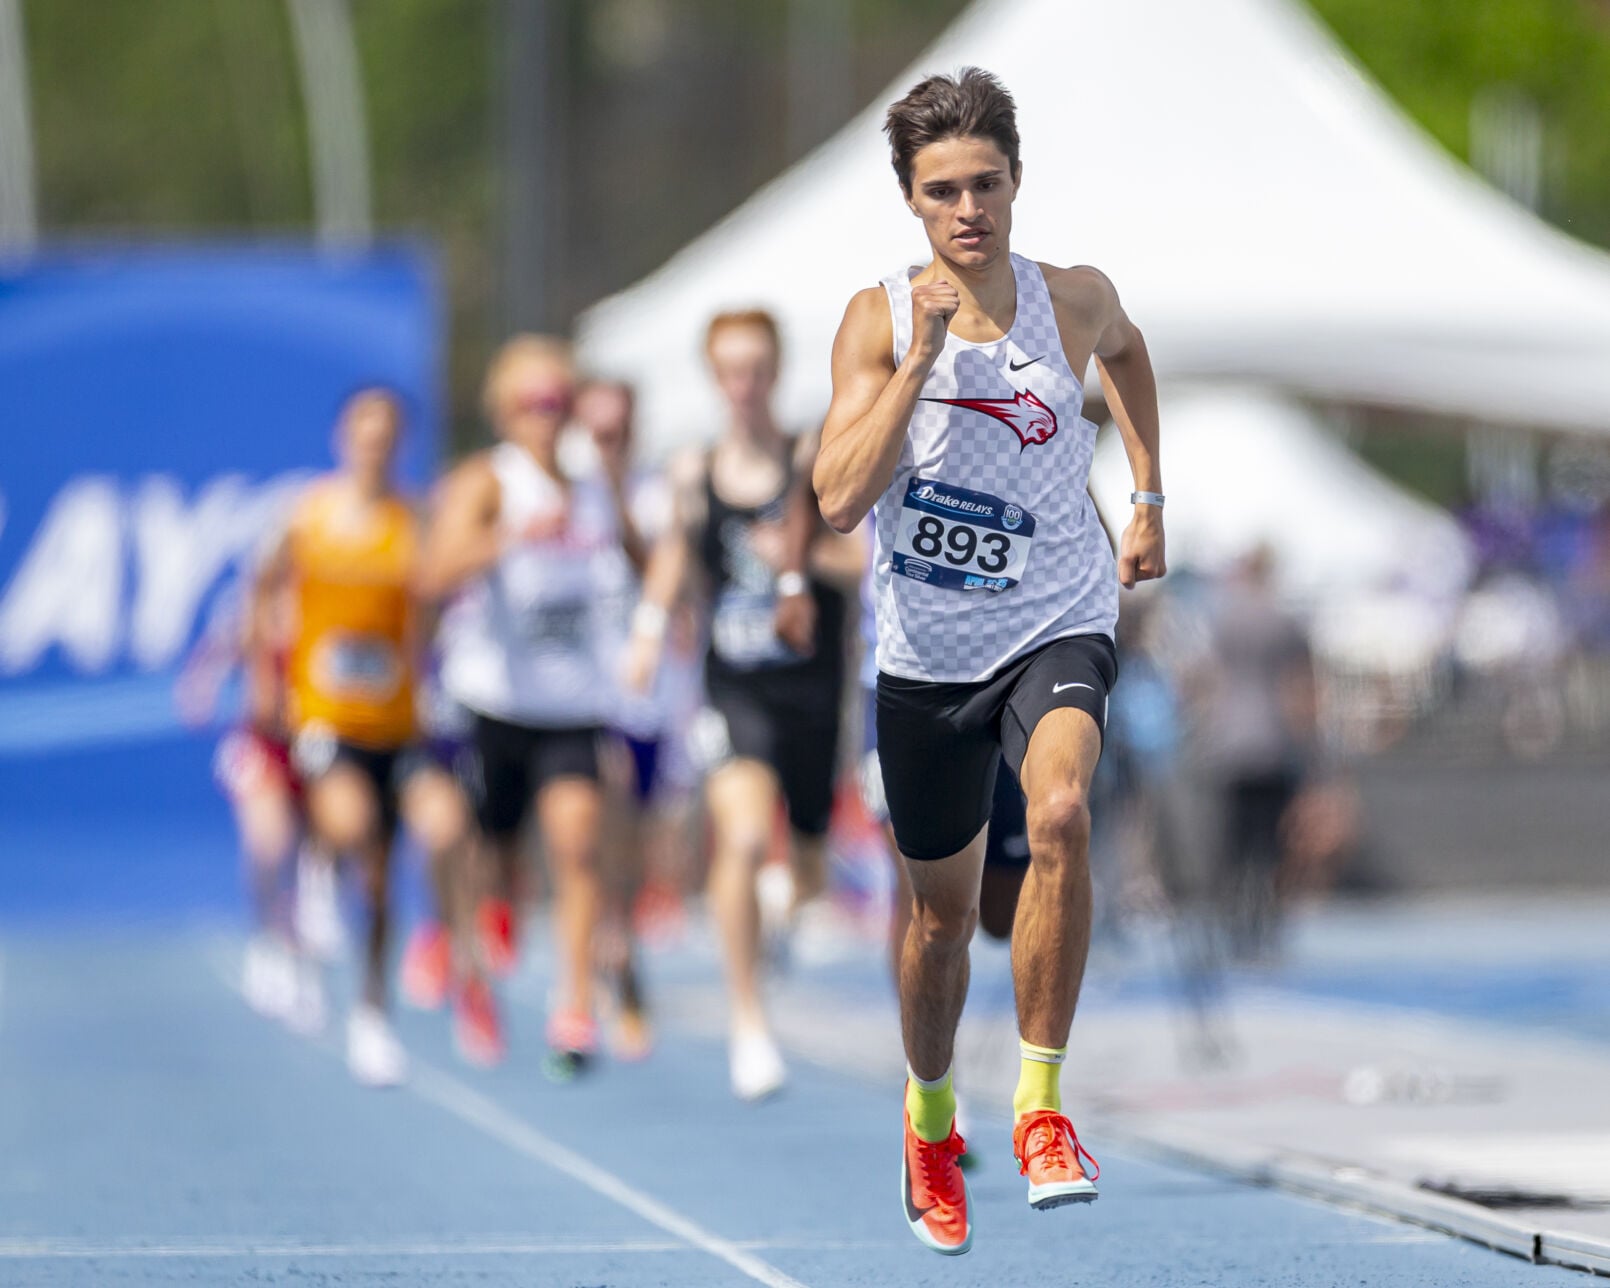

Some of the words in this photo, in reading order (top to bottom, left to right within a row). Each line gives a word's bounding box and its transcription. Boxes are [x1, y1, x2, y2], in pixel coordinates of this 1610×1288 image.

[918, 486, 960, 508] Drake
[959, 500, 993, 515] RELAYS
[1006, 509, 1021, 521] 100
[912, 516, 1011, 573] 893
[0, 470, 300, 672] AY
